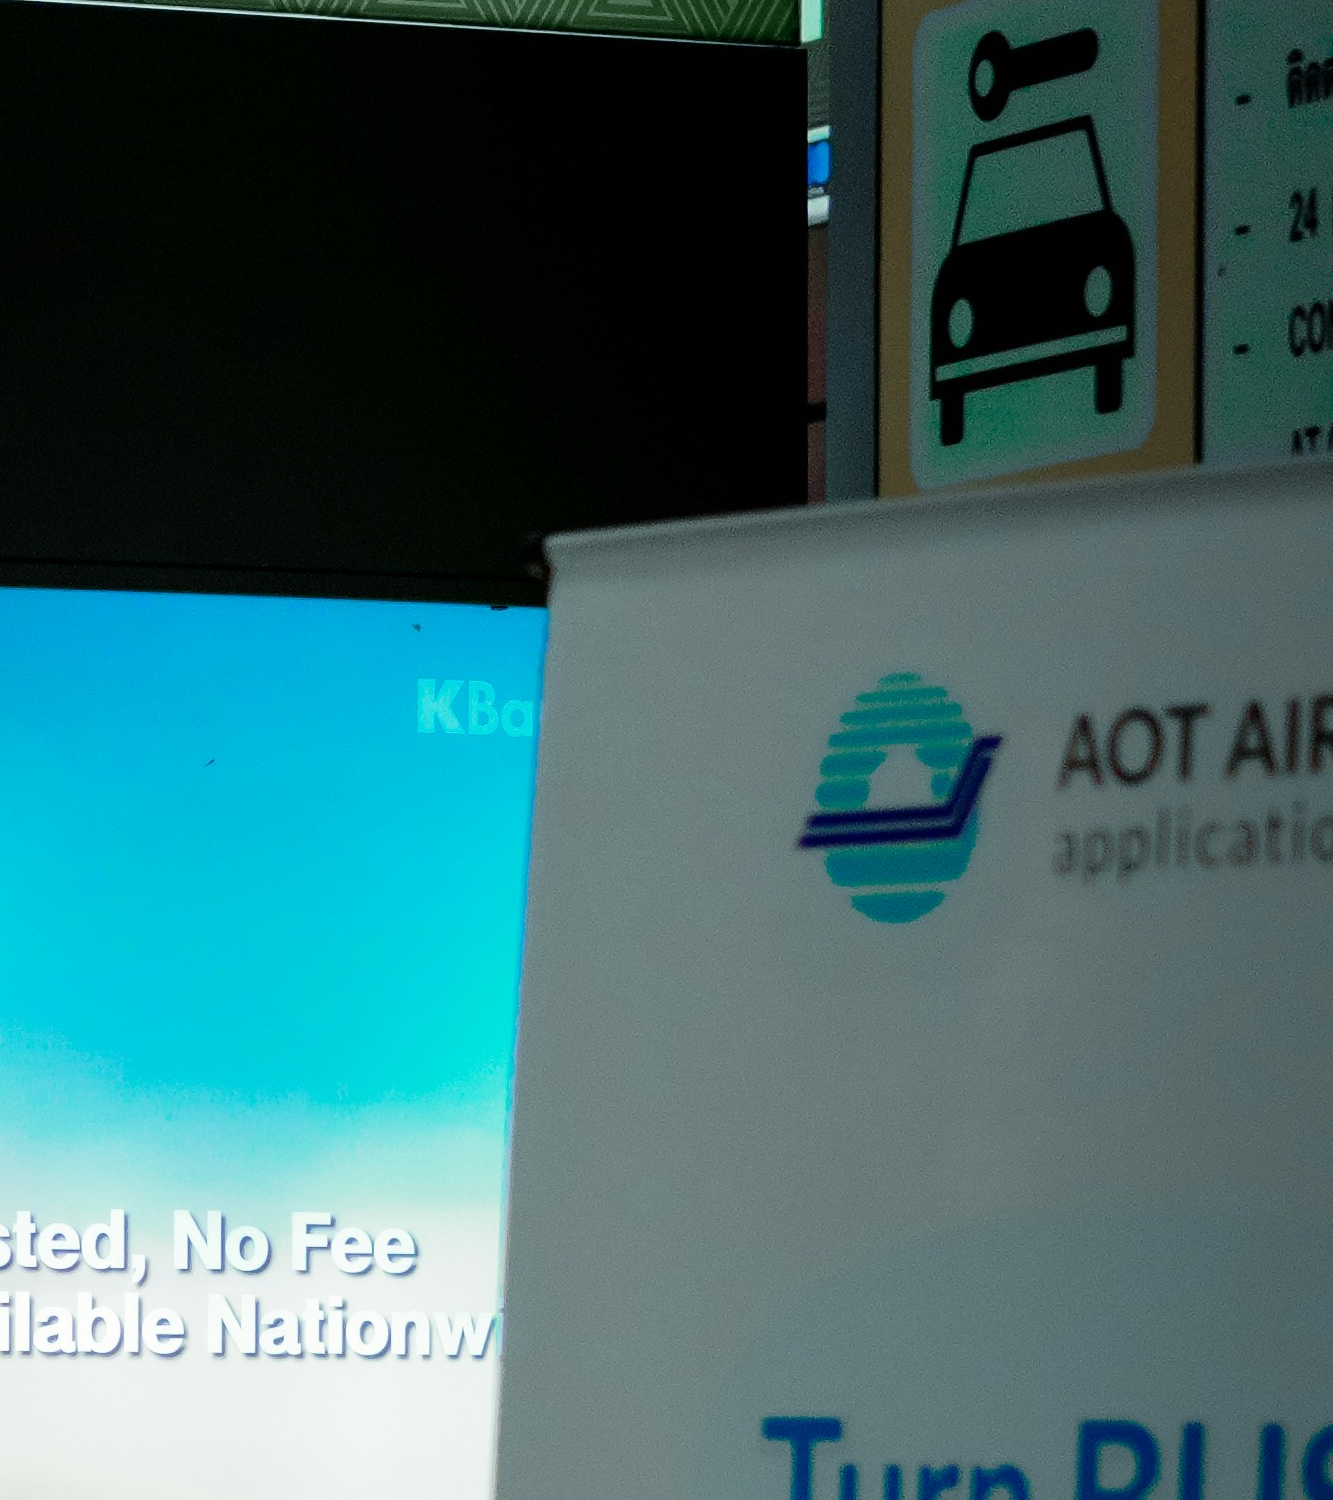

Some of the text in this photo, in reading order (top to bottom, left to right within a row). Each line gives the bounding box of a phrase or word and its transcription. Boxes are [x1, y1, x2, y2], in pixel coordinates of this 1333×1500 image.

[1057, 703, 1210, 785] AOT
[172, 1210, 270, 1274] No
[291, 1211, 418, 1275] Fee
